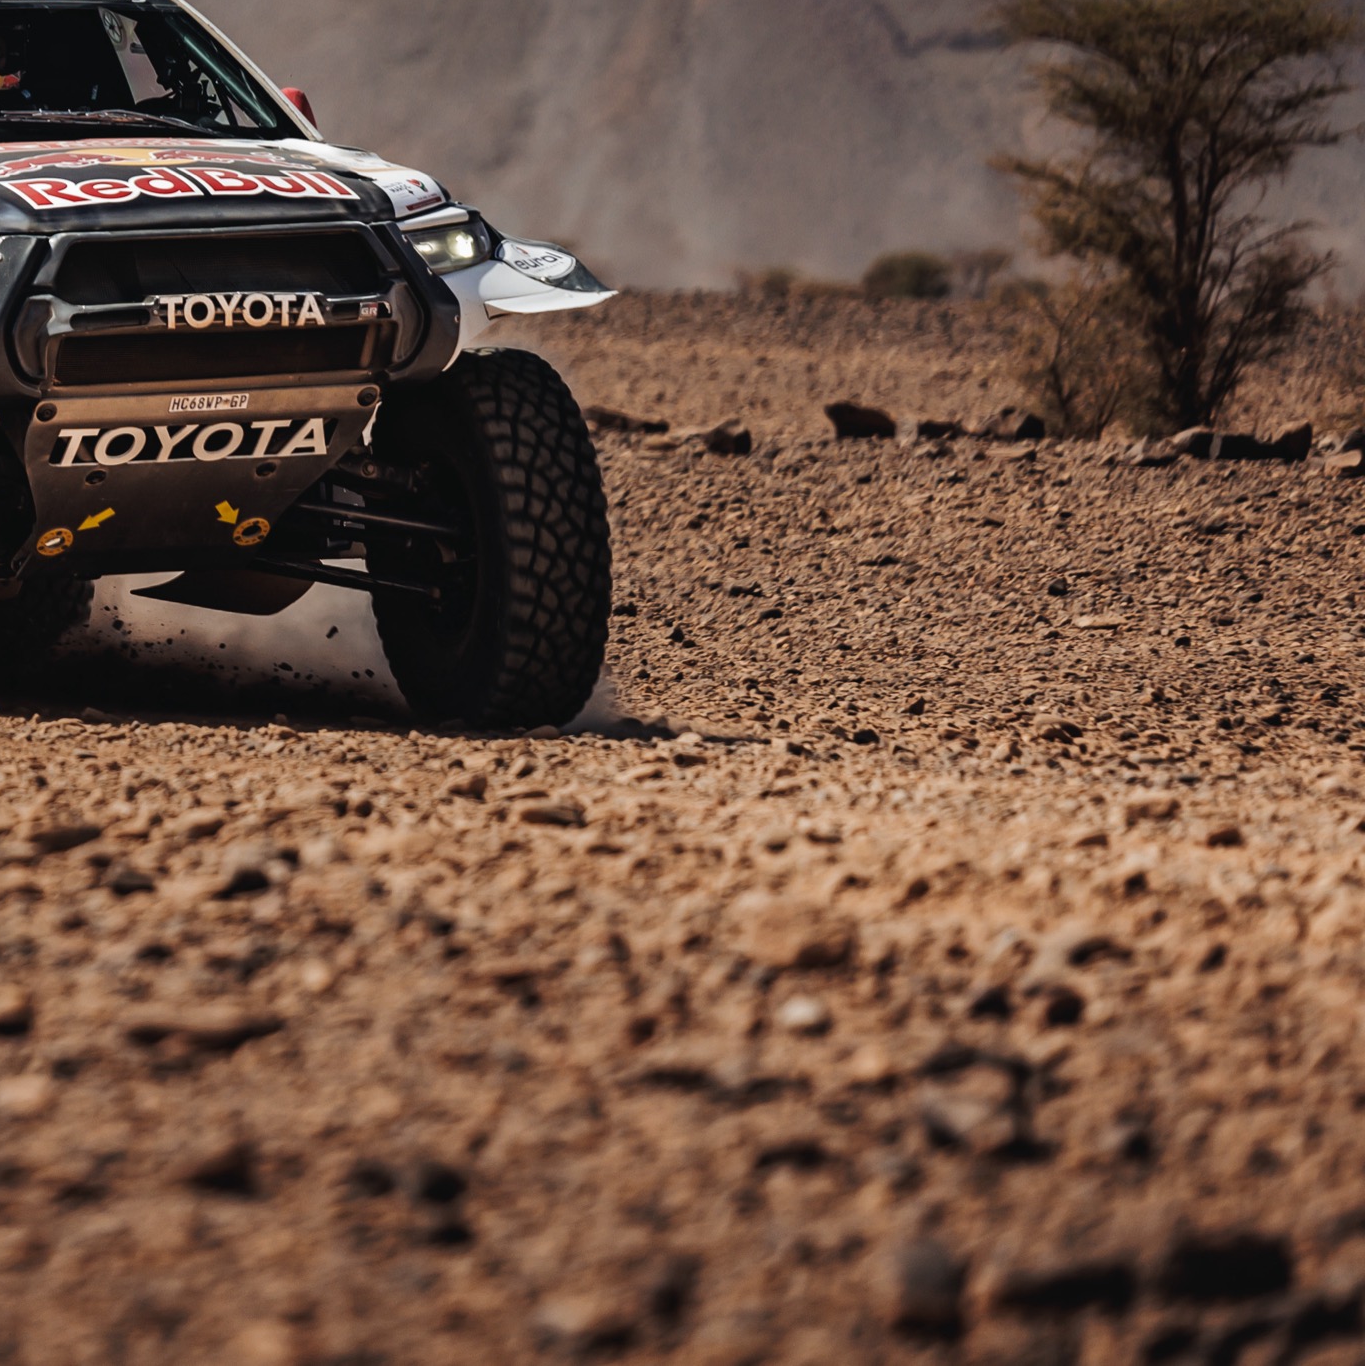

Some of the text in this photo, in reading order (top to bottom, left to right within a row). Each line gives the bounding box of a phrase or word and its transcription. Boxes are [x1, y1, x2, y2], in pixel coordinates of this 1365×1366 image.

[3, 167, 197, 208] Red
[183, 166, 358, 199] Bull
[514, 252, 563, 270] eurol
[159, 293, 326, 329] TOYOTA
[361, 306, 378, 316] GR
[171, 394, 247, 411] HC68WP GP
[58, 418, 327, 466] TOYOTA
